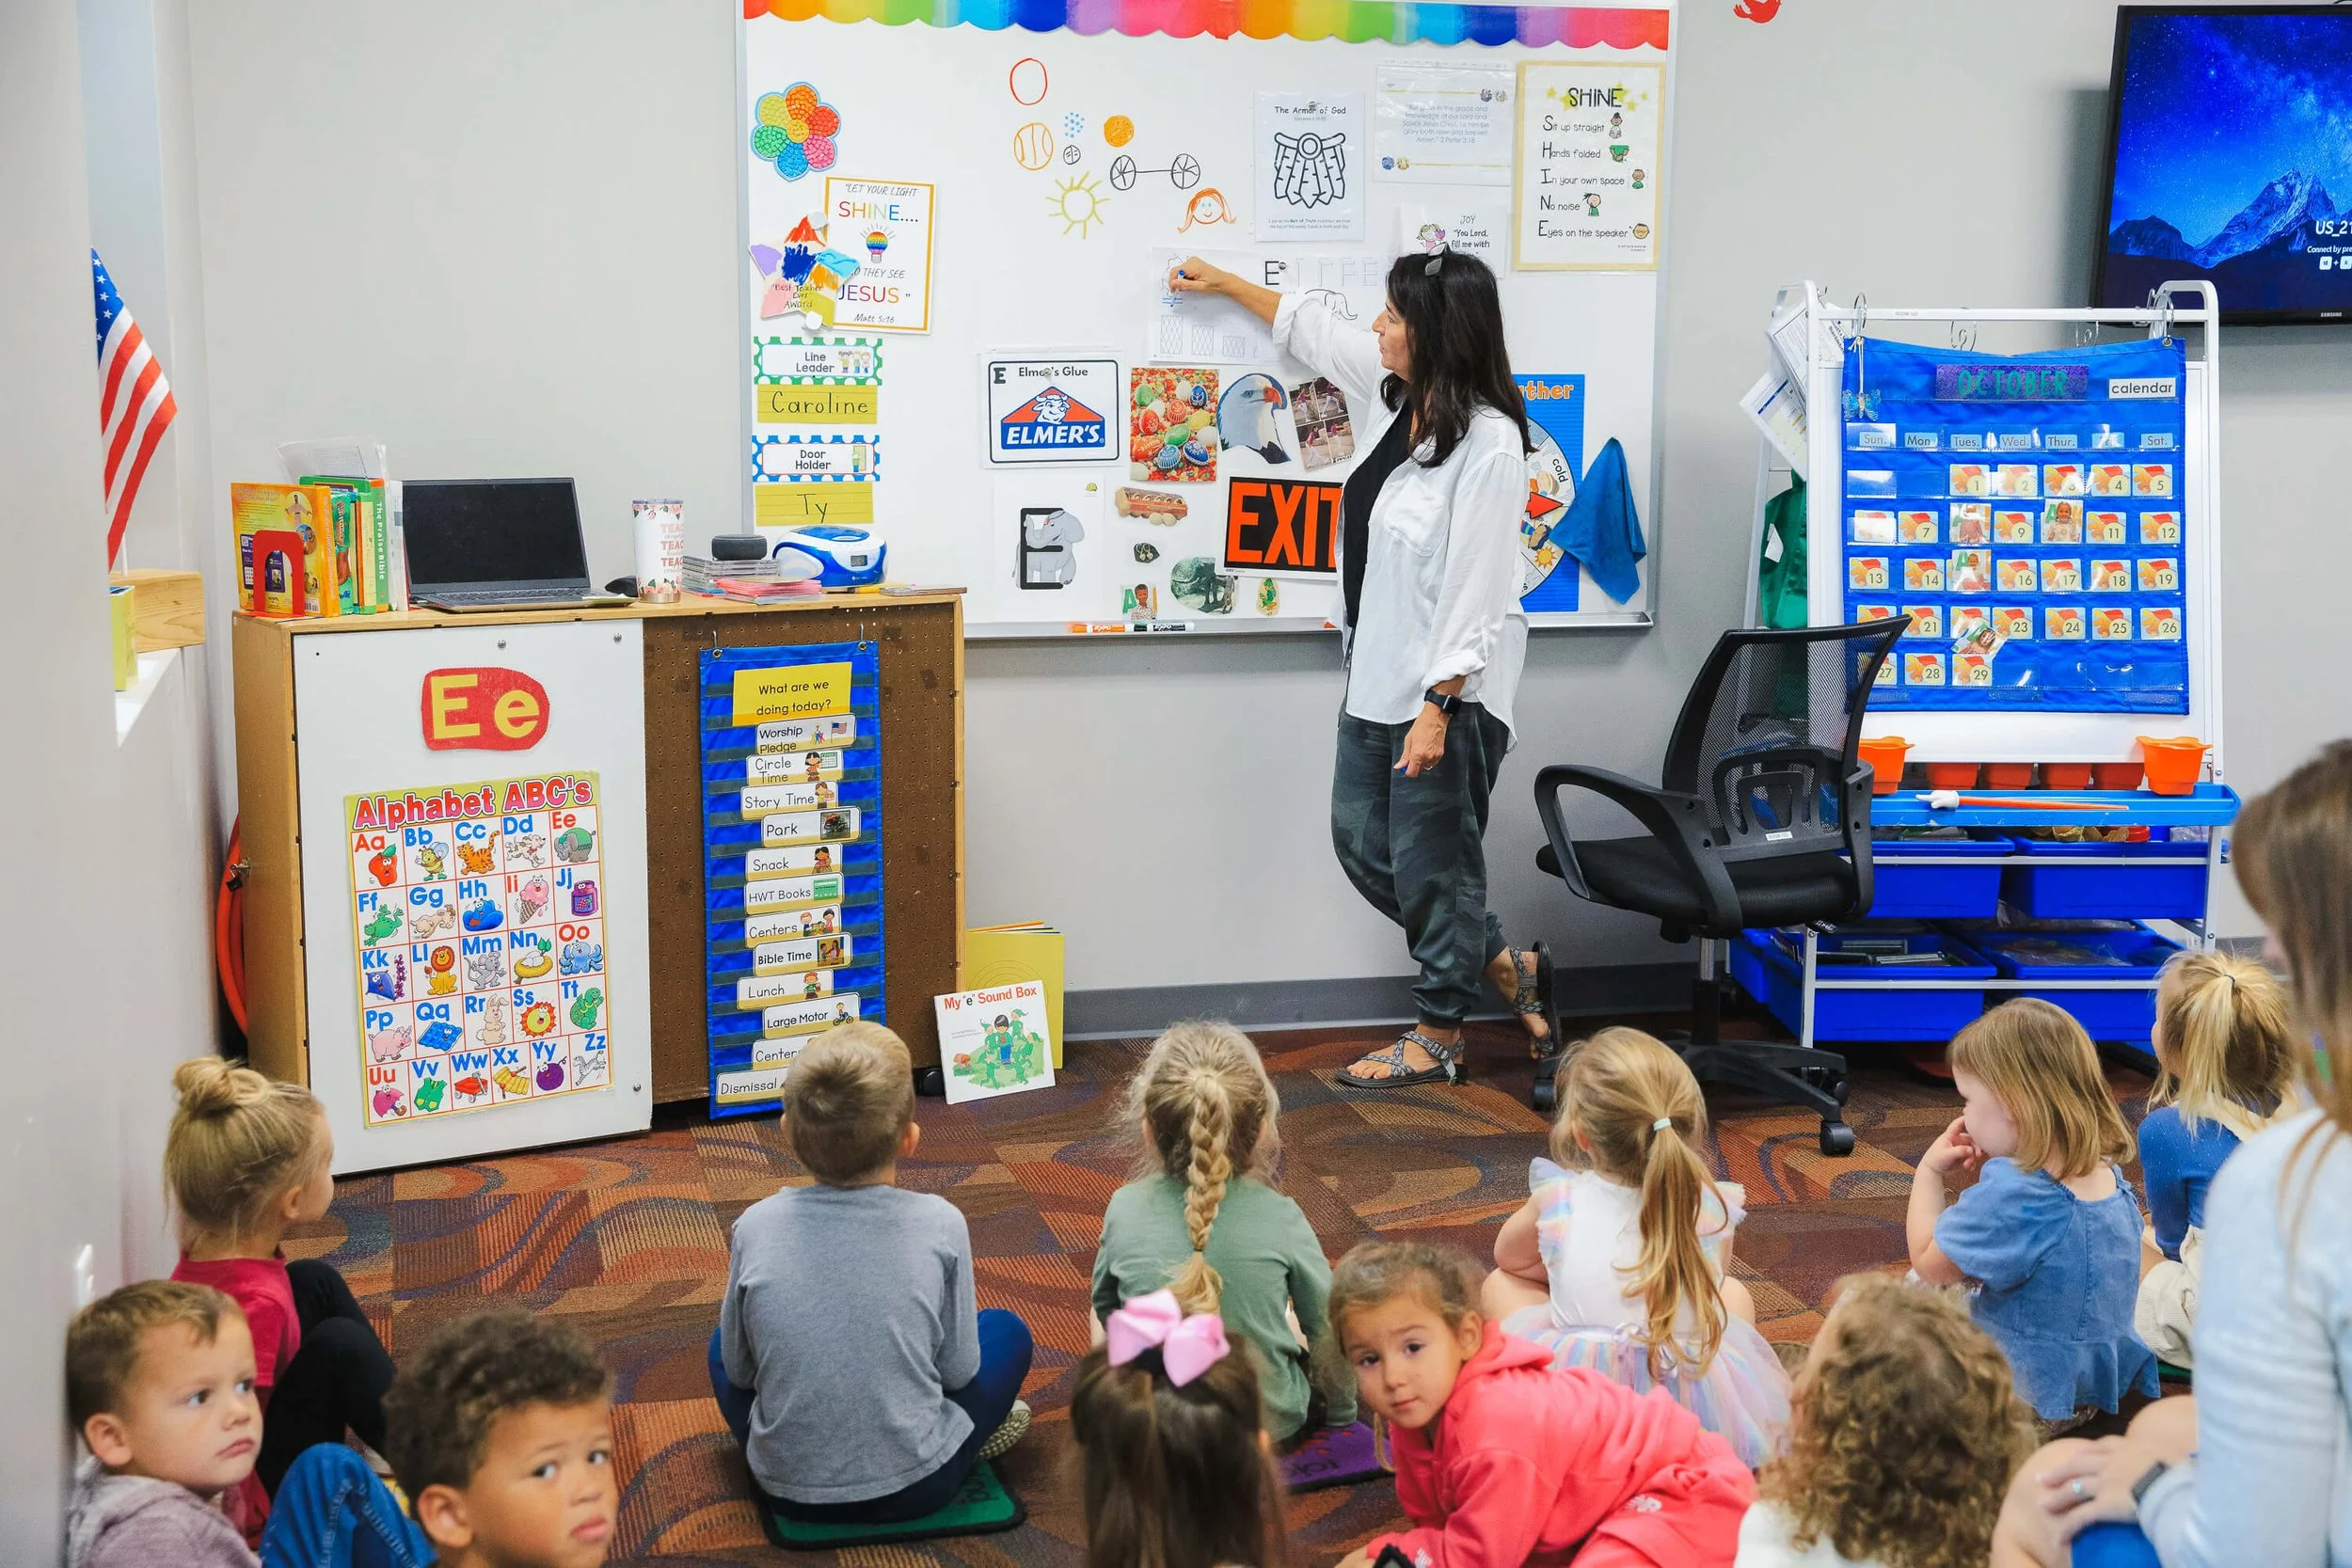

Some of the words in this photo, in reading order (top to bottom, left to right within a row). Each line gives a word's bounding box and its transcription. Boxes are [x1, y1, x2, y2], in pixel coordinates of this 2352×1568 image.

[1567, 87, 1623, 108] SHINE
[1561, 123, 1571, 132] up
[1573, 123, 1605, 133] straight
[1541, 141, 1570, 159] Hands
[1573, 149, 1601, 159] folded
[1540, 168, 1557, 184] In
[1559, 176, 1579, 186] your
[1581, 177, 1598, 185] own
[1599, 176, 1625, 187] space
[866, 184, 888, 196] YOUR
[890, 185, 918, 197] LIGHT
[1540, 195, 1555, 211] No
[1558, 201, 1581, 211] noise
[1460, 215, 1476, 225] JOY
[1538, 220, 1564, 239] Eyes
[1565, 229, 1577, 237] on
[1578, 228, 1593, 237] the
[1595, 229, 1629, 239] speaker
[1473, 240, 1490, 248] with
[2333, 245, 2342, 254] by
[863, 267, 886, 278] THEY
[887, 269, 907, 278] SEE
[1264, 261, 1279, 286] E
[838, 283, 900, 304] JESUS
[853, 313, 875, 323] Matt
[878, 314, 896, 324] 5:16
[804, 352, 826, 362] Line
[796, 362, 834, 372] Leader
[993, 367, 1007, 384] E
[1019, 366, 1059, 377] Elme's
[1062, 366, 1089, 376] Glue
[1958, 370, 2068, 396] OCTOBER
[2111, 381, 2174, 395] calendar
[771, 390, 868, 414] Caroline
[1007, 424, 1101, 445] ELMER'S
[1864, 434, 1887, 444] Sun.
[1954, 436, 1979, 447] Tues.
[2001, 436, 2030, 447] Wed.
[2047, 436, 2075, 447] Thur.
[2147, 436, 2168, 445] Sat.
[800, 450, 826, 459] Door
[795, 460, 832, 470] Holder
[1552, 458, 1568, 483] cold
[2022, 481, 2028, 491] 2
[2115, 480, 2122, 491] 4
[2156, 480, 2164, 491] 5
[796, 493, 828, 523] Ty
[1227, 482, 1343, 568] EXIT
[1922, 528, 1930, 538] 7
[2018, 528, 2026, 538] 9
[2108, 528, 2119, 539] 11
[2162, 528, 2176, 539] 12
[1869, 574, 1883, 584] 13
[1926, 575, 1939, 585] 14
[2019, 575, 2032, 585] 16
[2063, 575, 2076, 585] 17
[2113, 575, 2126, 586] 18
[2159, 574, 2173, 584] 19
[1924, 622, 1937, 632] 21
[2013, 622, 2028, 632] 23
[2065, 622, 2080, 633] 24
[2112, 623, 2127, 634] 25
[2162, 622, 2177, 633] 26
[1878, 668, 1892, 678] 27
[1925, 668, 1940, 679] 28
[1973, 669, 1988, 680] 29
[758, 684, 787, 695] What
[790, 683, 809, 692] are
[813, 681, 829, 690] we
[430, 674, 540, 739] Ee
[756, 705, 789, 716] doing
[792, 699, 832, 712] today?
[758, 726, 803, 739] Worship
[759, 742, 797, 754] Pledge
[755, 756, 791, 771] Circle
[758, 770, 788, 784] Time
[354, 786, 495, 832] Alphabet
[503, 776, 592, 813] ABC's
[744, 796, 780, 810] Story
[786, 792, 815, 805] Time
[355, 833, 385, 853] Aa
[405, 829, 433, 847] Bb
[455, 822, 486, 841] Cc
[502, 815, 533, 835] Dd
[552, 812, 577, 829] Ee
[766, 822, 798, 837] Park
[753, 857, 789, 871] Snack
[358, 893, 377, 912] Ff
[409, 886, 443, 908] Gg
[458, 879, 487, 900] Hh
[507, 875, 518, 893] Ii
[556, 867, 573, 890] Jj
[749, 891, 774, 903] HWT
[778, 888, 811, 900] Books
[749, 924, 798, 939] Centers
[361, 950, 389, 970] Kk
[412, 943, 428, 963] Ll
[462, 936, 502, 957] Mm
[509, 929, 538, 949] Nn
[558, 924, 591, 942] Oo
[757, 954, 784, 965] Bible
[787, 951, 813, 962] Time
[748, 983, 785, 999] Lunch
[944, 997, 961, 1010] My
[977, 989, 1012, 1005] Sound
[1015, 986, 1038, 998] Box
[365, 1009, 393, 1031] Pp
[416, 1002, 450, 1022] Qq
[465, 995, 485, 1014] Rr
[513, 989, 534, 1008] Ss
[561, 981, 579, 999] Tt
[767, 1017, 797, 1029] Large
[799, 1011, 829, 1023] Motor
[369, 1067, 396, 1085] Uu
[412, 1059, 438, 1078] Vv
[452, 1053, 488, 1072] Ww
[493, 1047, 519, 1067] Xx
[532, 1041, 557, 1061] Yy
[584, 1033, 607, 1052] Zz
[755, 1048, 800, 1062] Center
[721, 1078, 777, 1095] Dismissal
